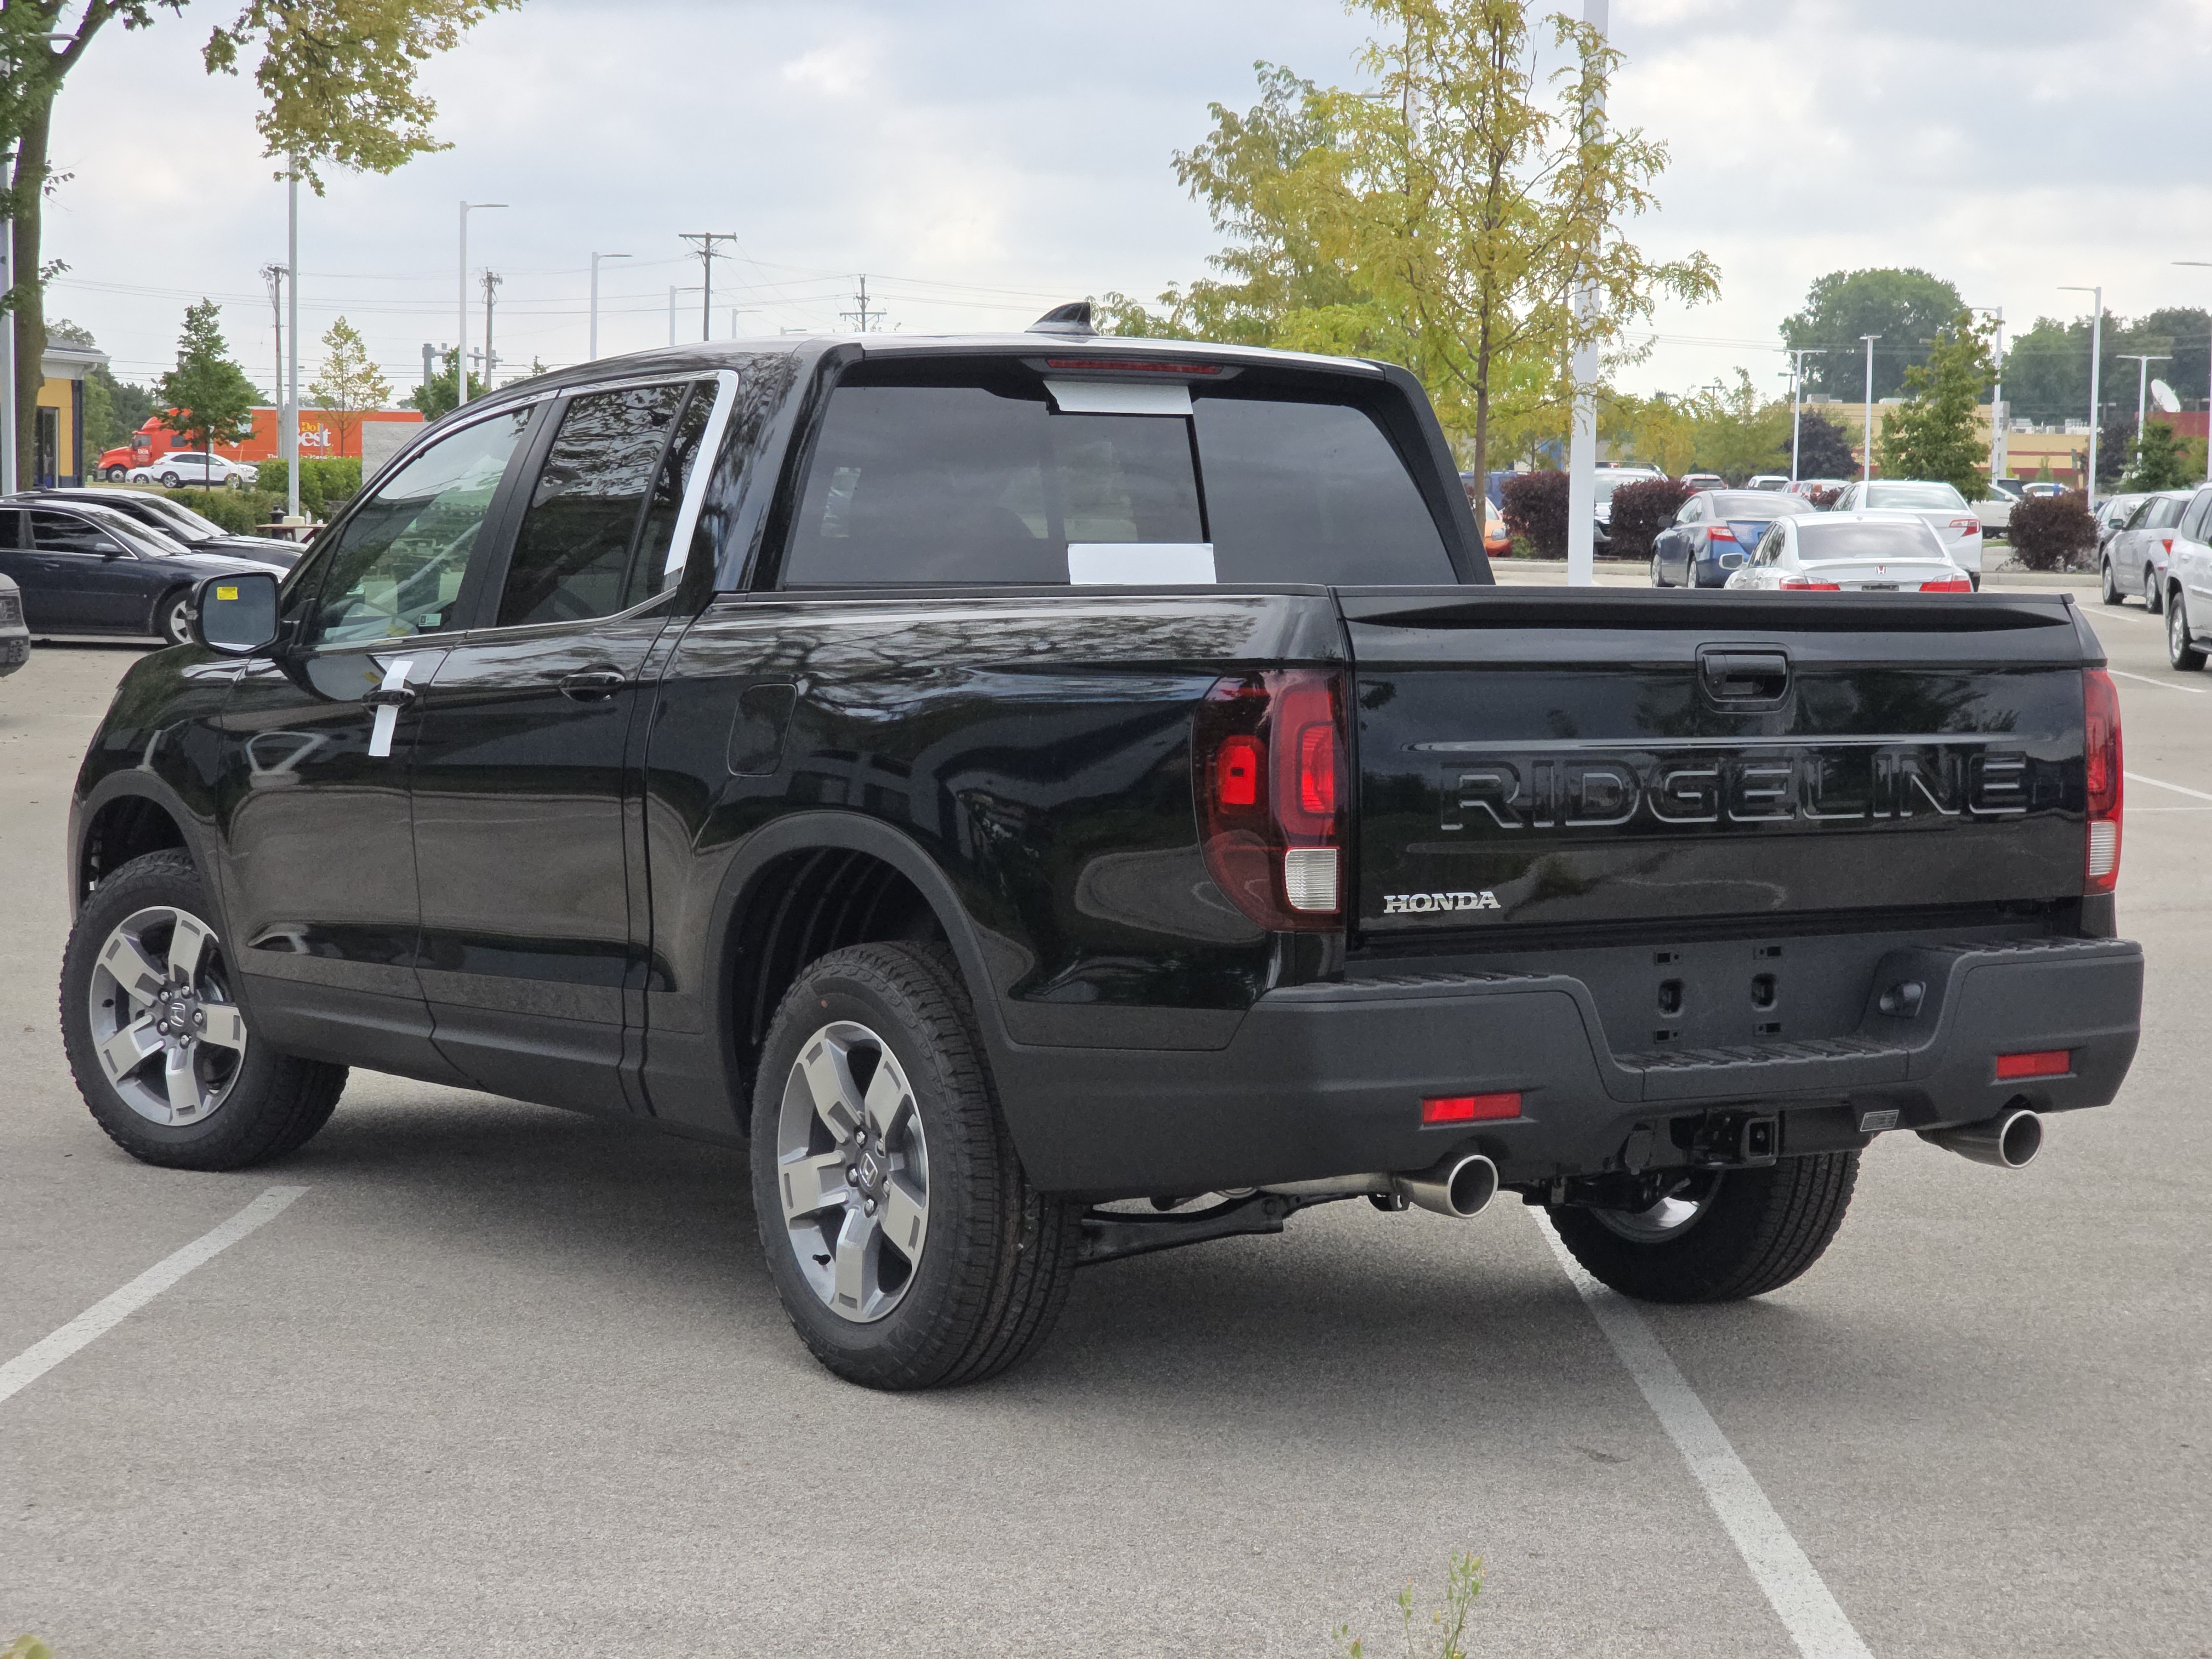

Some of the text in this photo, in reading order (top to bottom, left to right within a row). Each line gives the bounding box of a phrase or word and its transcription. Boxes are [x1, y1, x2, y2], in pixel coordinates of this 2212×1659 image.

[301, 421, 316, 431] Do
[1440, 751, 2027, 830] RIDGELINE
[1384, 891, 1501, 914] HONDA
